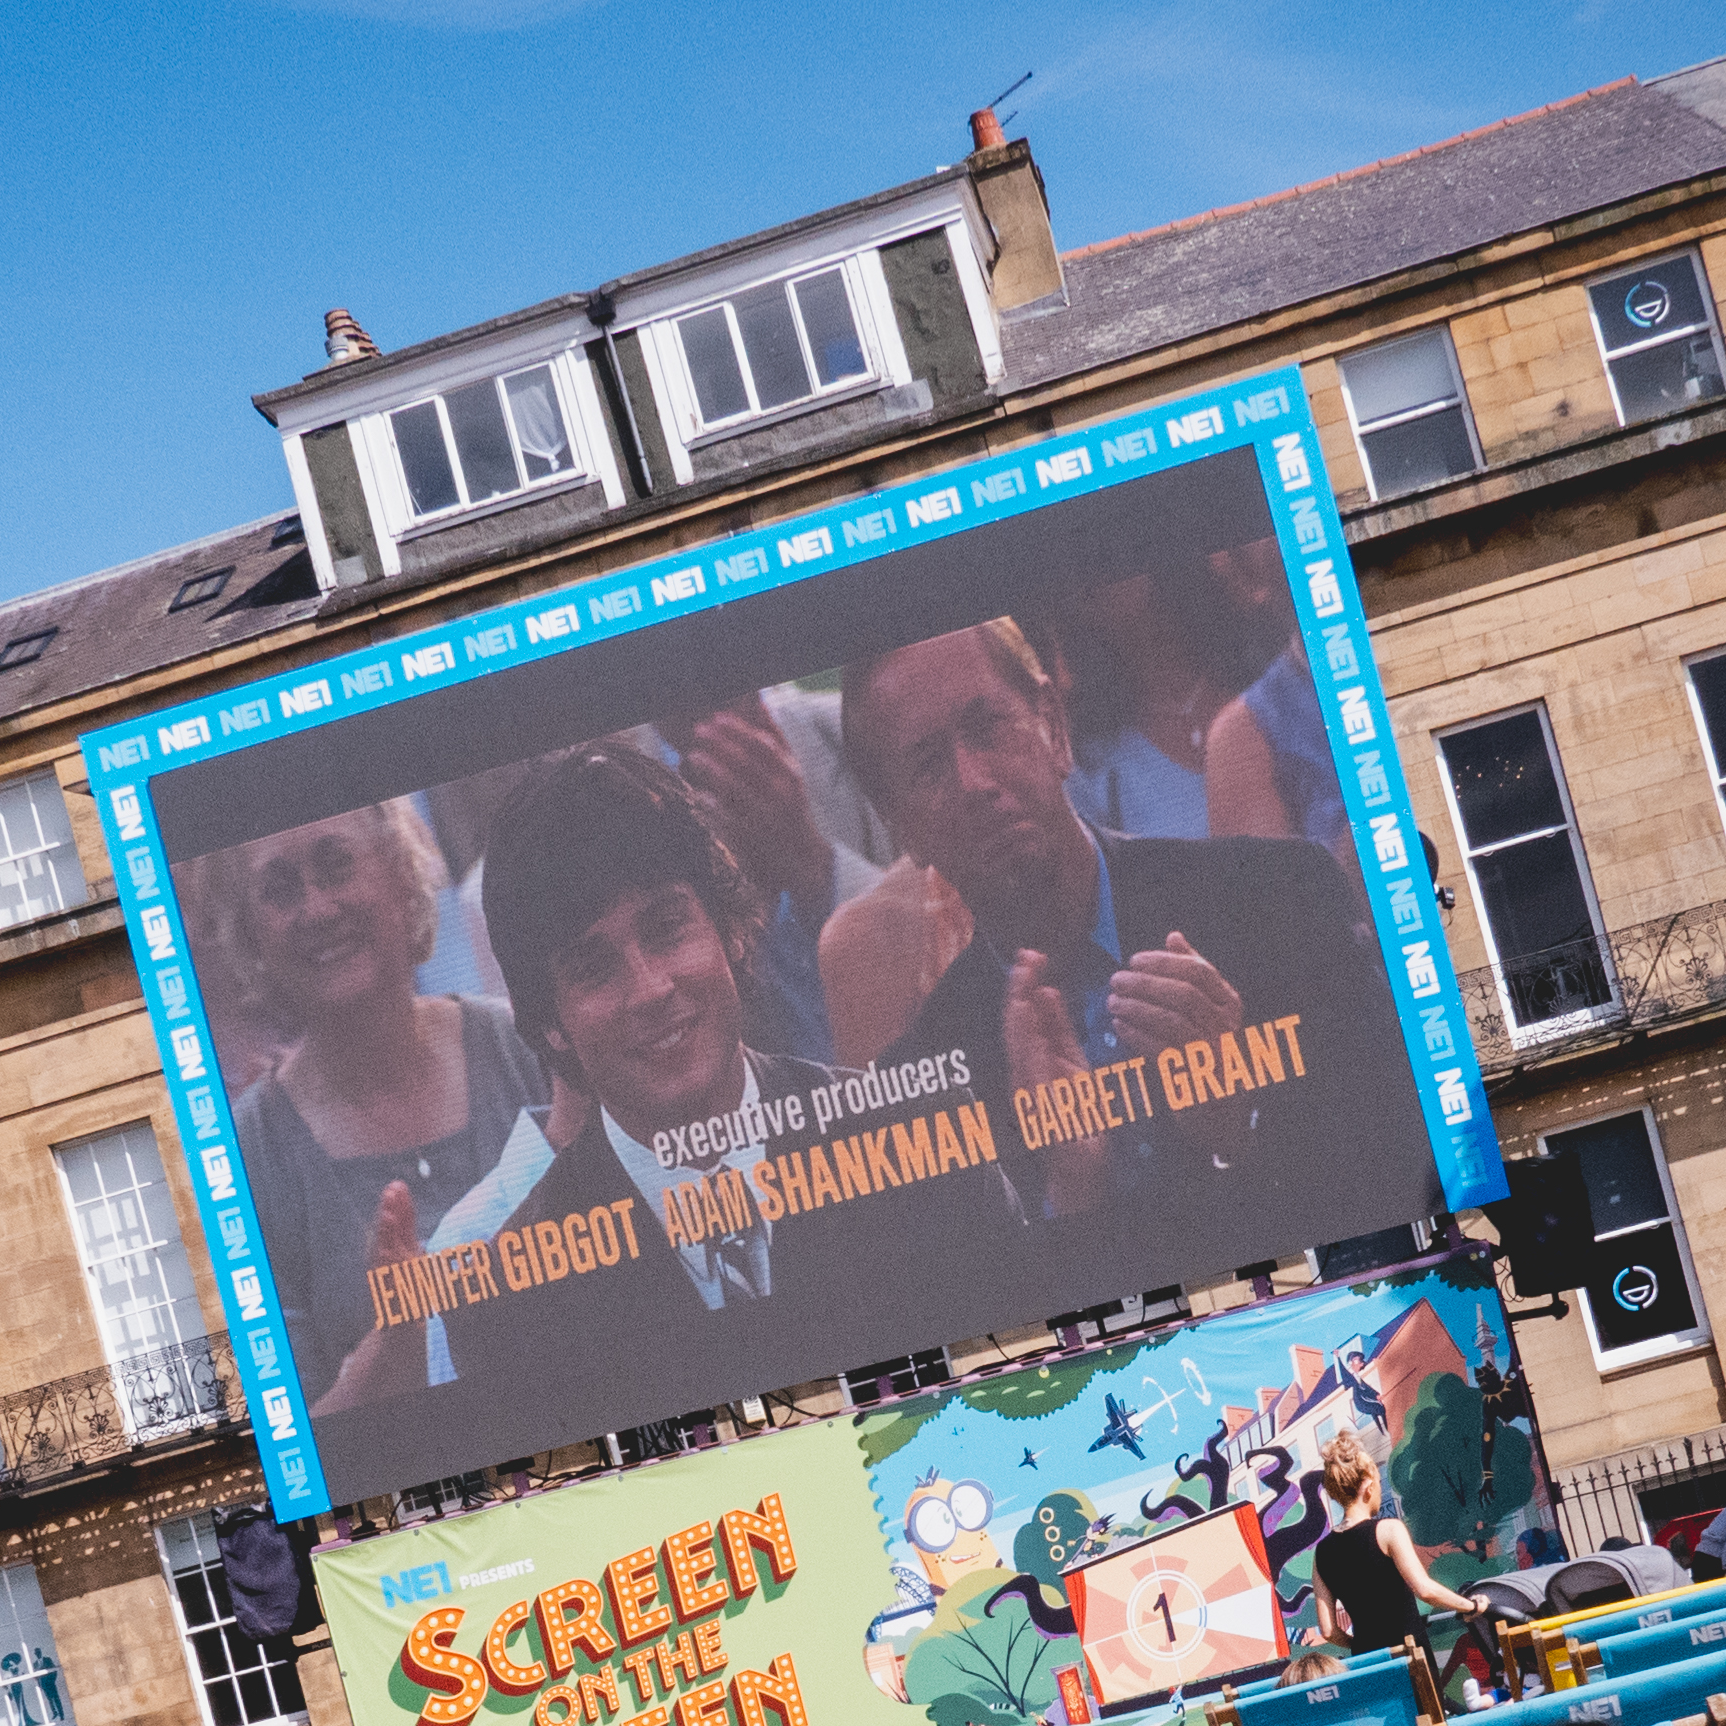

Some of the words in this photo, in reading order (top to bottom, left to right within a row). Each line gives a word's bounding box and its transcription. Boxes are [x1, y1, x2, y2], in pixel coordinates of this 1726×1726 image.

[1273, 437, 1314, 493] NE1
[1290, 497, 1328, 555] NE1
[100, 736, 151, 773] NE1
[158, 717, 212, 756] NE1
[220, 700, 271, 736] NE1
[280, 680, 334, 719] NE1
[342, 663, 394, 699] NE1
[402, 643, 457, 682] NE1
[465, 625, 518, 662] NE1
[526, 605, 582, 645] NE1
[590, 587, 643, 625] NE1
[651, 567, 707, 607] NE1
[716, 549, 769, 586] NE1
[778, 527, 835, 569] NE1
[843, 510, 897, 548] NE1
[906, 488, 963, 529] NE1
[972, 469, 1027, 508] NE1
[1036, 447, 1094, 490] NE1
[1103, 429, 1158, 468] NE1
[1167, 406, 1226, 449] NE1
[1234, 388, 1291, 427] NE1
[1305, 559, 1345, 620] NE1
[1323, 624, 1361, 682] NE1
[1338, 686, 1378, 746] NE1
[1355, 751, 1392, 808] NE1
[110, 785, 147, 843] NE1
[1370, 814, 1410, 873] NE1
[127, 847, 161, 901] NE1
[141, 906, 177, 962] NE1
[1388, 879, 1424, 935] NE1
[157, 967, 191, 1021] NE1
[1403, 941, 1442, 1000] NE1
[171, 1025, 208, 1082] NE1
[1421, 1007, 1456, 1061] NE1
[652, 1095, 805, 1168] executive
[811, 1048, 970, 1134] producers
[1013, 1057, 1153, 1150] GARRETT
[1157, 1014, 1306, 1111] GRANT
[1435, 1068, 1473, 1127] NE1
[187, 1086, 221, 1141] NE1
[200, 1145, 238, 1202] NE1
[662, 1168, 752, 1248] ADAM
[752, 1102, 997, 1221] SHANKMAN
[218, 1208, 251, 1261] NE1
[367, 1239, 499, 1330] JENNIFER
[498, 1198, 640, 1292] GIBGOT
[232, 1266, 268, 1322] NE1
[249, 1328, 281, 1380] NE1
[263, 1387, 298, 1442] NE1
[280, 1449, 311, 1500] NE1
[379, 1560, 453, 1608] NE1
[459, 1558, 535, 1590] PRESENTS
[1153, 1592, 1176, 1642] 1
[1638, 1609, 1672, 1628] NE1
[624, 1618, 729, 1700] THE
[1307, 1685, 1339, 1703] NE1
[1569, 1694, 1621, 1721] NE1
